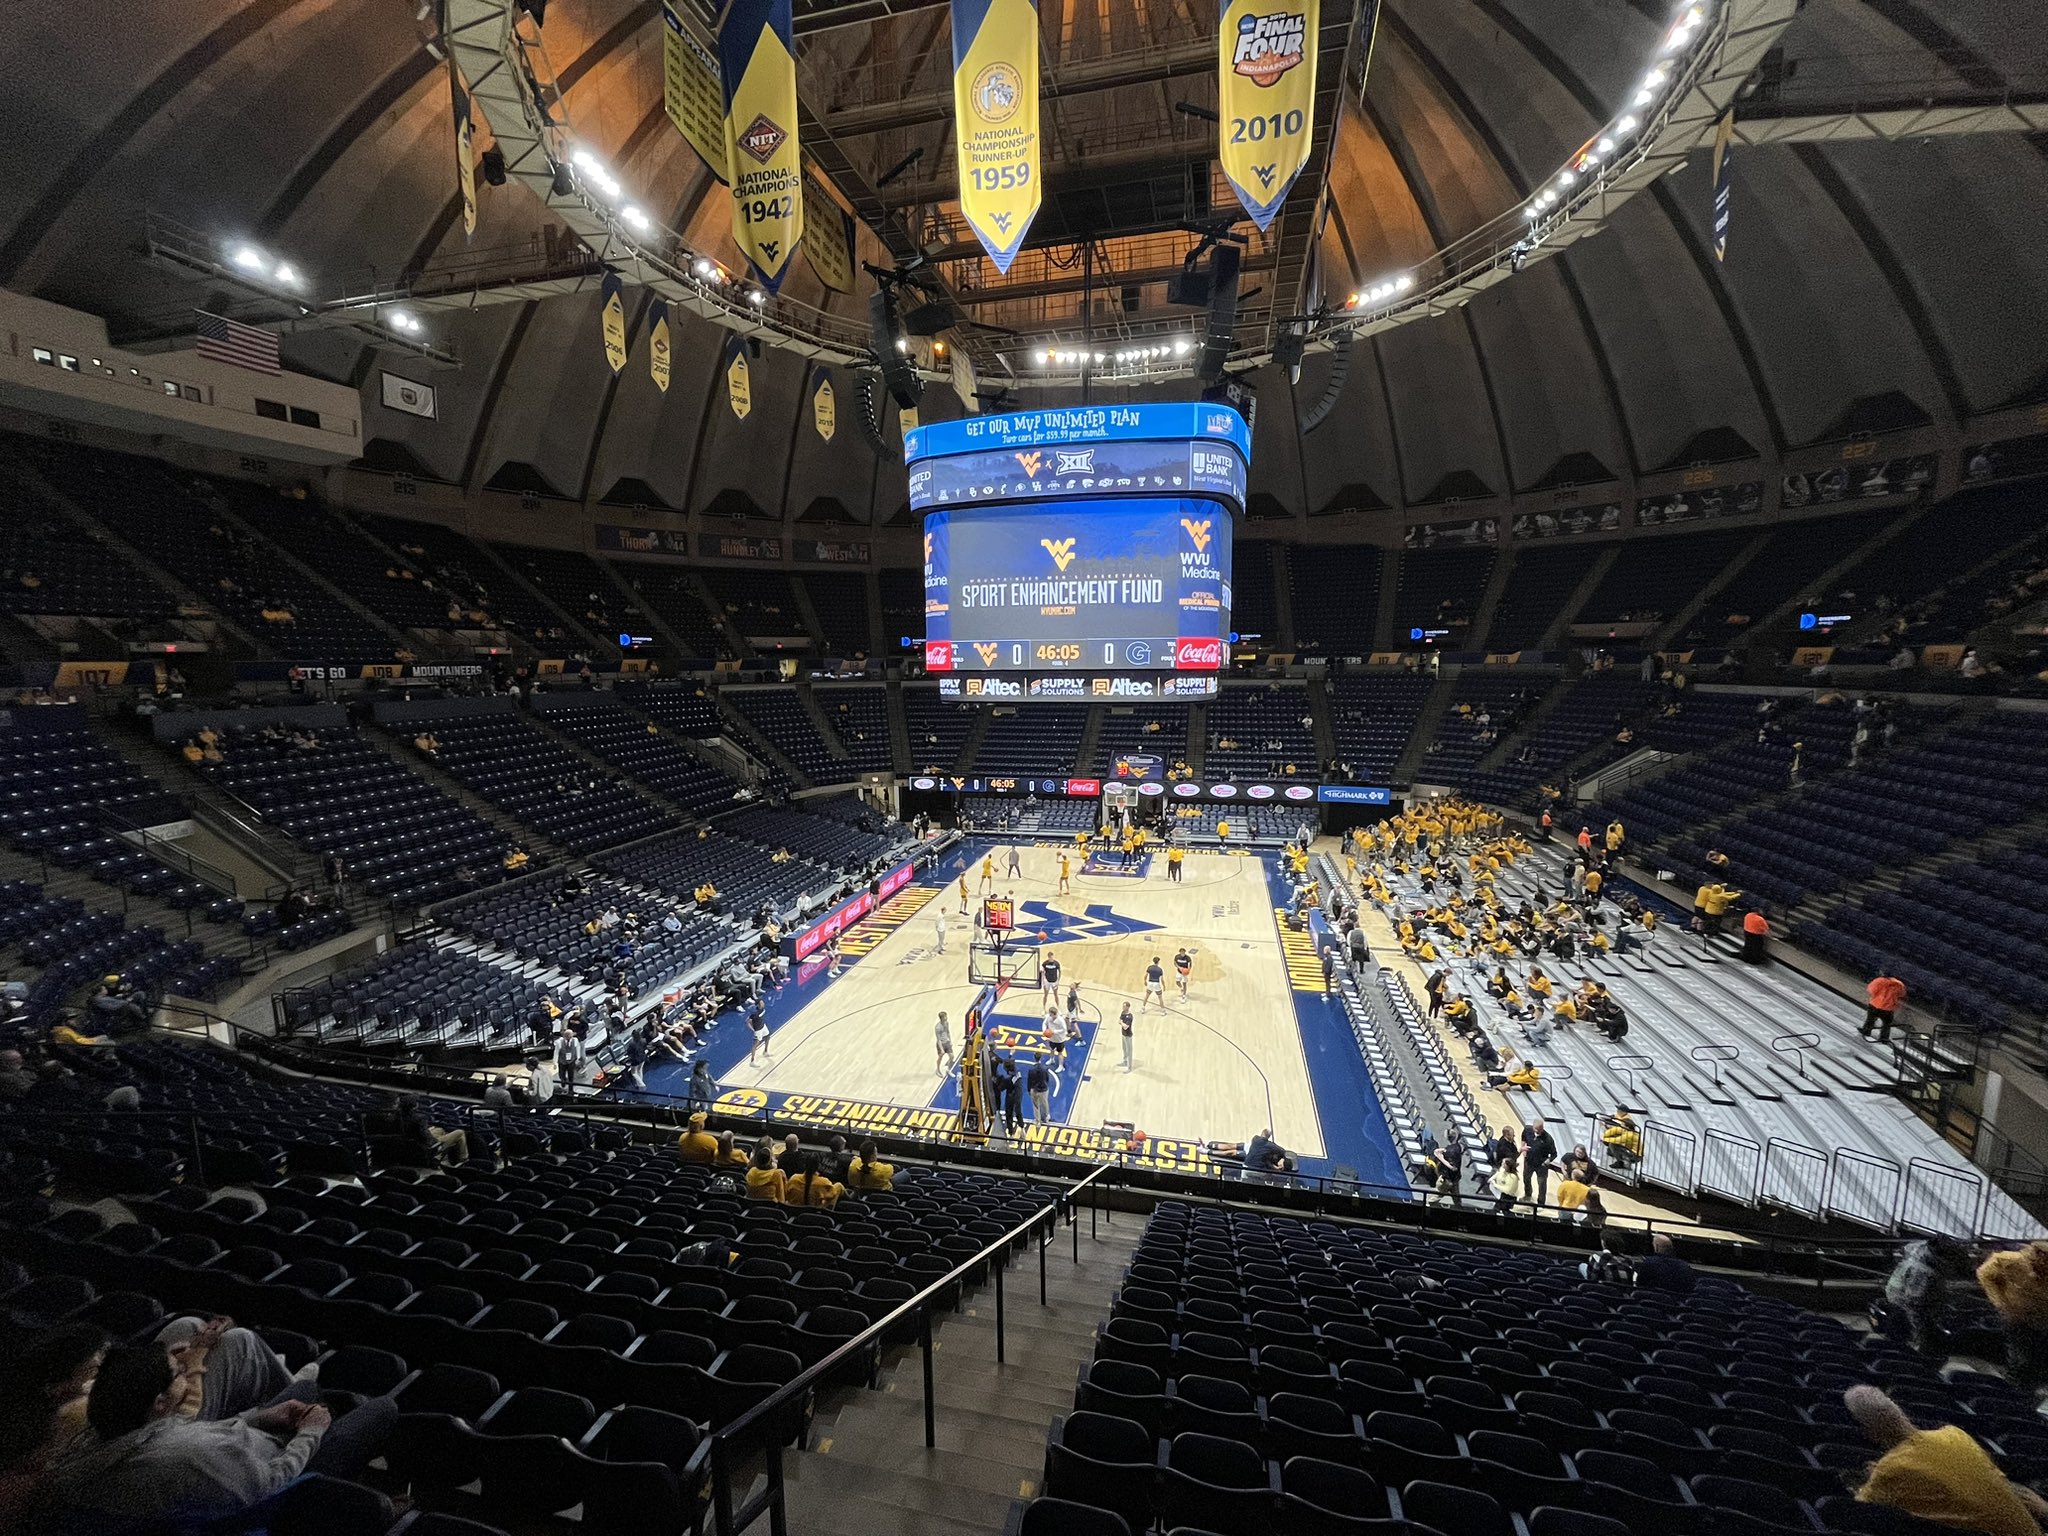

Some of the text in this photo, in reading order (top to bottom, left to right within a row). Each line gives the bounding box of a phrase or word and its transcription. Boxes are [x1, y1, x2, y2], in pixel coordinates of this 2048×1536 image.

[1254, 16, 1304, 39] FINAL
[1234, 32, 1303, 64] FOUR
[1239, 56, 1298, 72] INDIANAPOLIS
[974, 126, 1024, 141] NATIONAL
[1231, 109, 1303, 144] 2010
[749, 132, 777, 148] NIT
[962, 133, 1035, 152] CHAMPIONSHIP
[972, 147, 1027, 163] RUNNER-UP
[737, 166, 792, 186] NATIONAL
[970, 161, 1030, 191] 1959
[732, 175, 800, 199] CHAMPIONS
[741, 195, 794, 224] 1942
[966, 408, 1140, 437] GET OUR MVP UNLIMITED PLAN
[1002, 435, 1017, 444] Two
[1033, 430, 1045, 444] for
[1046, 430, 1068, 440] $59.99
[1069, 430, 1082, 442] per
[1083, 426, 1109, 438] month.
[1842, 441, 1877, 459] 227
[1206, 452, 1232, 468] UNITED
[1206, 464, 1228, 476] BANK
[720, 545, 760, 558] HUNDLEY
[1180, 552, 1210, 566] WVU
[1182, 566, 1220, 580] Medicine
[962, 580, 1162, 608] SPORT ENHANCEMENT FUND
[1012, 644, 1022, 665] 0
[1036, 644, 1080, 660] 46:05
[1104, 643, 1114, 664] 0
[329, 667, 346, 678] GO
[412, 665, 482, 677] MOUNTAINEERS
[1042, 678, 1085, 688] SUPPLY
[990, 779, 1014, 788] 46:05
[1324, 790, 1368, 800] HIGHMARK
[838, 924, 894, 956] WEST
